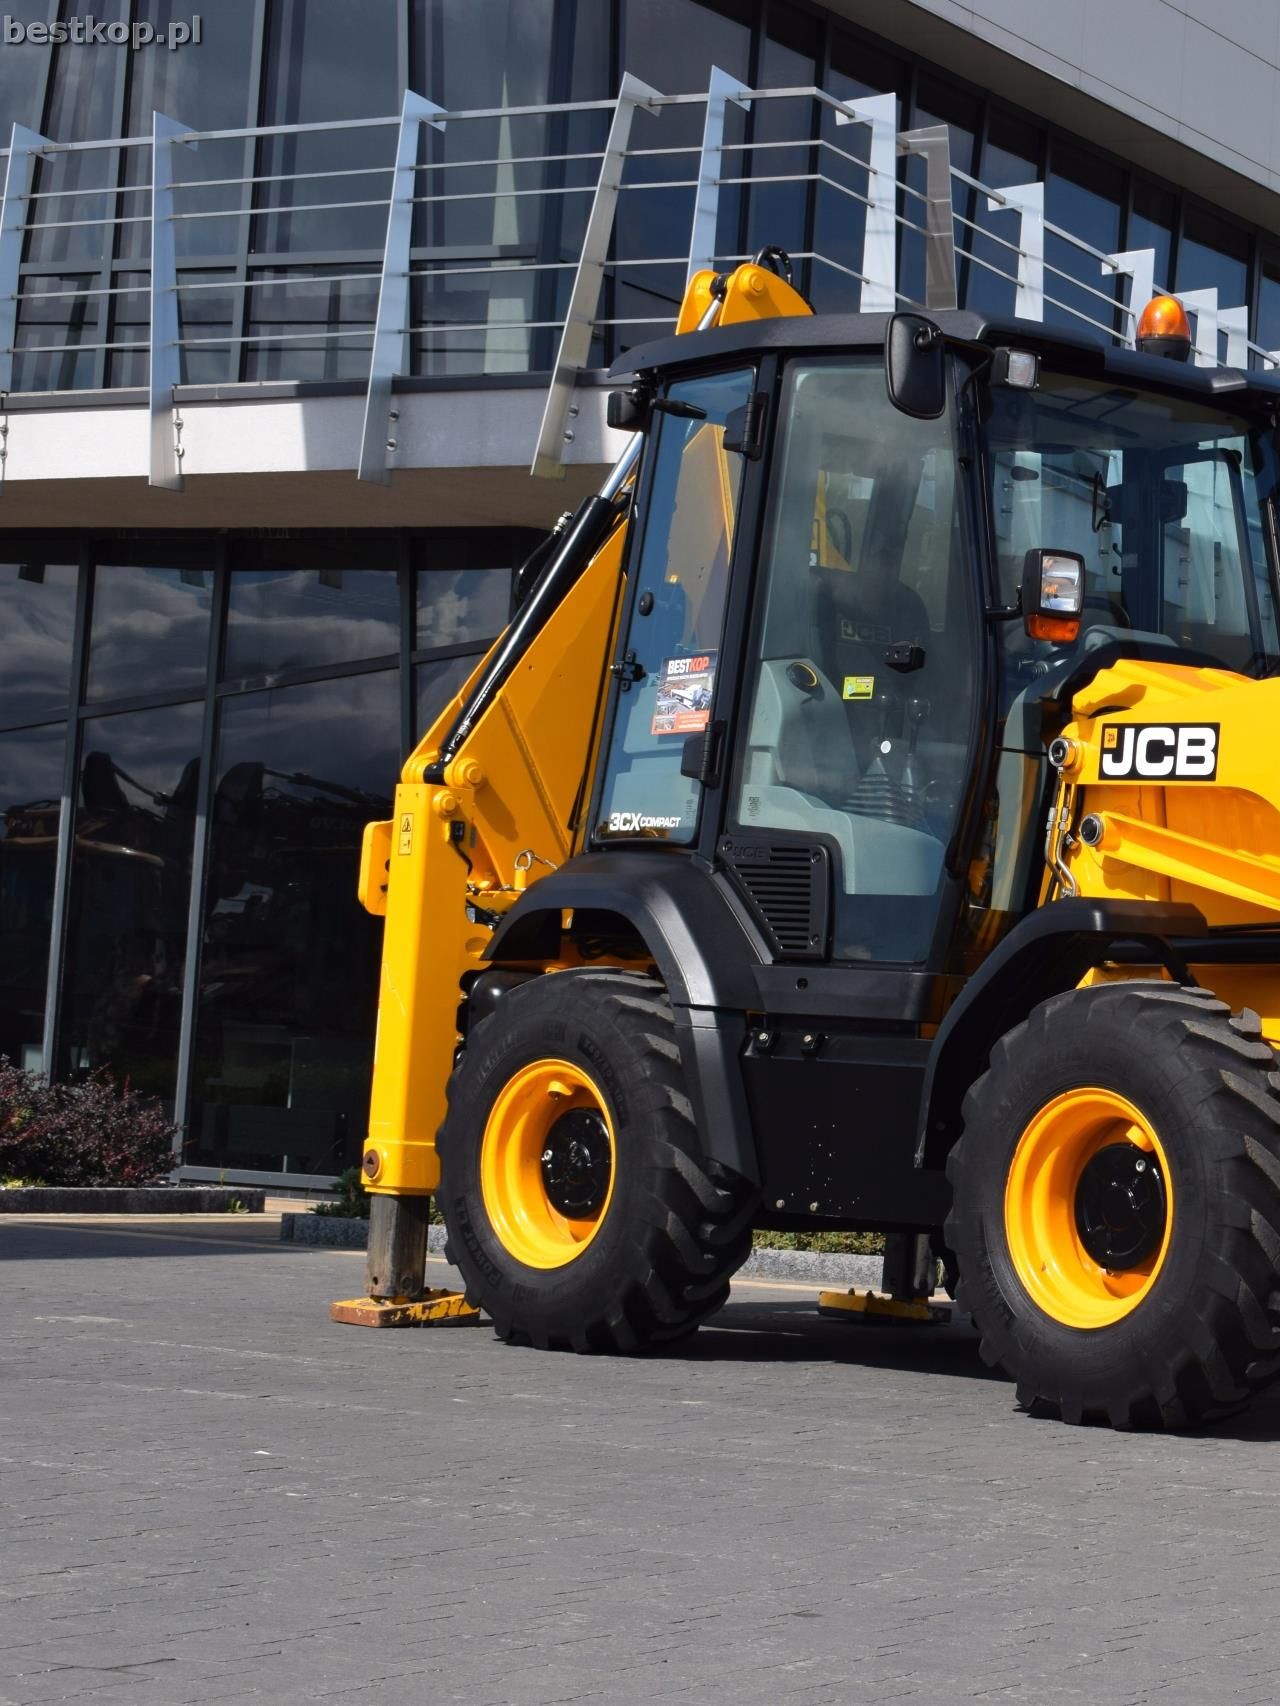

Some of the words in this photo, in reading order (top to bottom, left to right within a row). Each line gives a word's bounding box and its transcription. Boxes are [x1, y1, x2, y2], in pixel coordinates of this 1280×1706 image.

[667, 656, 710, 674] BESTKOP
[1102, 727, 1216, 776] JCB
[609, 812, 643, 831] 3CX
[640, 816, 682, 828] COMPACT
